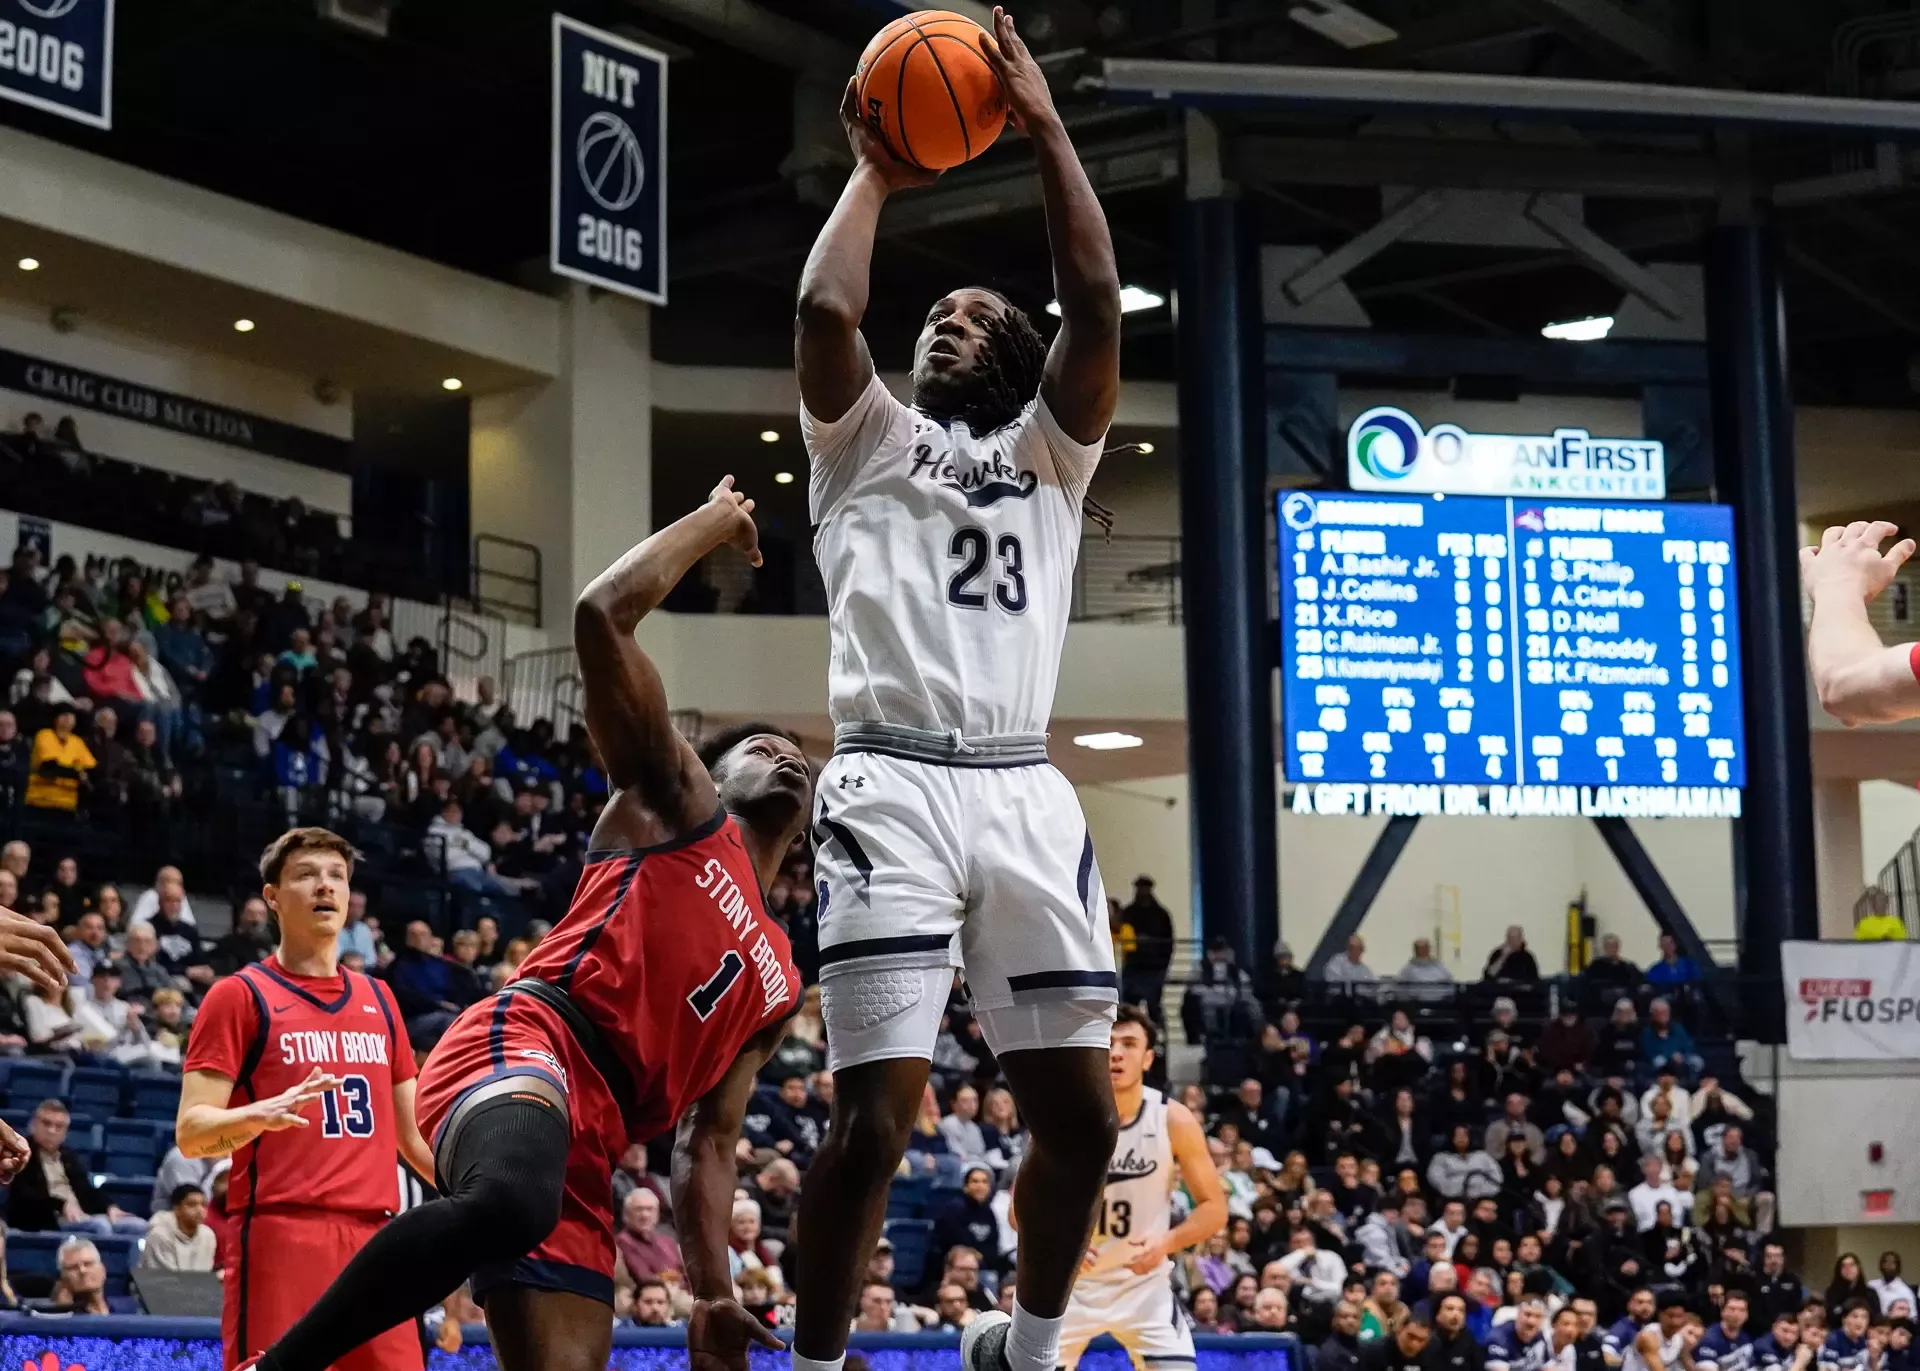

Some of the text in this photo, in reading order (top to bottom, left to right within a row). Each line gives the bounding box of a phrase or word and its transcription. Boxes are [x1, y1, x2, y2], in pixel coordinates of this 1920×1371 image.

[0, 19, 85, 92] 2006
[582, 50, 640, 108] NIT
[577, 212, 643, 271] 2016
[25, 364, 253, 442] CRAIG CLUB SECTION
[1433, 431, 1657, 472] OANFIRST
[946, 524, 1029, 616] 23
[1320, 554, 1410, 576] A.Bashir
[1413, 556, 1440, 578] Jr.
[1550, 560, 1634, 586] S.Philip
[1321, 579, 1418, 602] J.Collins
[1551, 585, 1645, 608] A.Clarke
[1323, 604, 1397, 628] X.Rice
[1553, 611, 1619, 633] D.Noll
[1554, 636, 1657, 664] A.Snoddy
[1369, 753, 1386, 778] 2
[1432, 754, 1445, 779] 1
[1604, 758, 1618, 782] 1
[1292, 783, 1312, 815] A
[1314, 783, 1368, 815] GIFT
[1371, 784, 1441, 816] FROM
[1444, 785, 1486, 816] DR.
[1489, 786, 1579, 817] RAMAN
[695, 858, 790, 1018] STONY BROOK
[686, 949, 746, 1023] 1
[1821, 997, 1920, 1024] FLOSP
[280, 1030, 389, 1067] STONY BROOK
[319, 1073, 375, 1138] 13
[1098, 1199, 1132, 1239] 13
